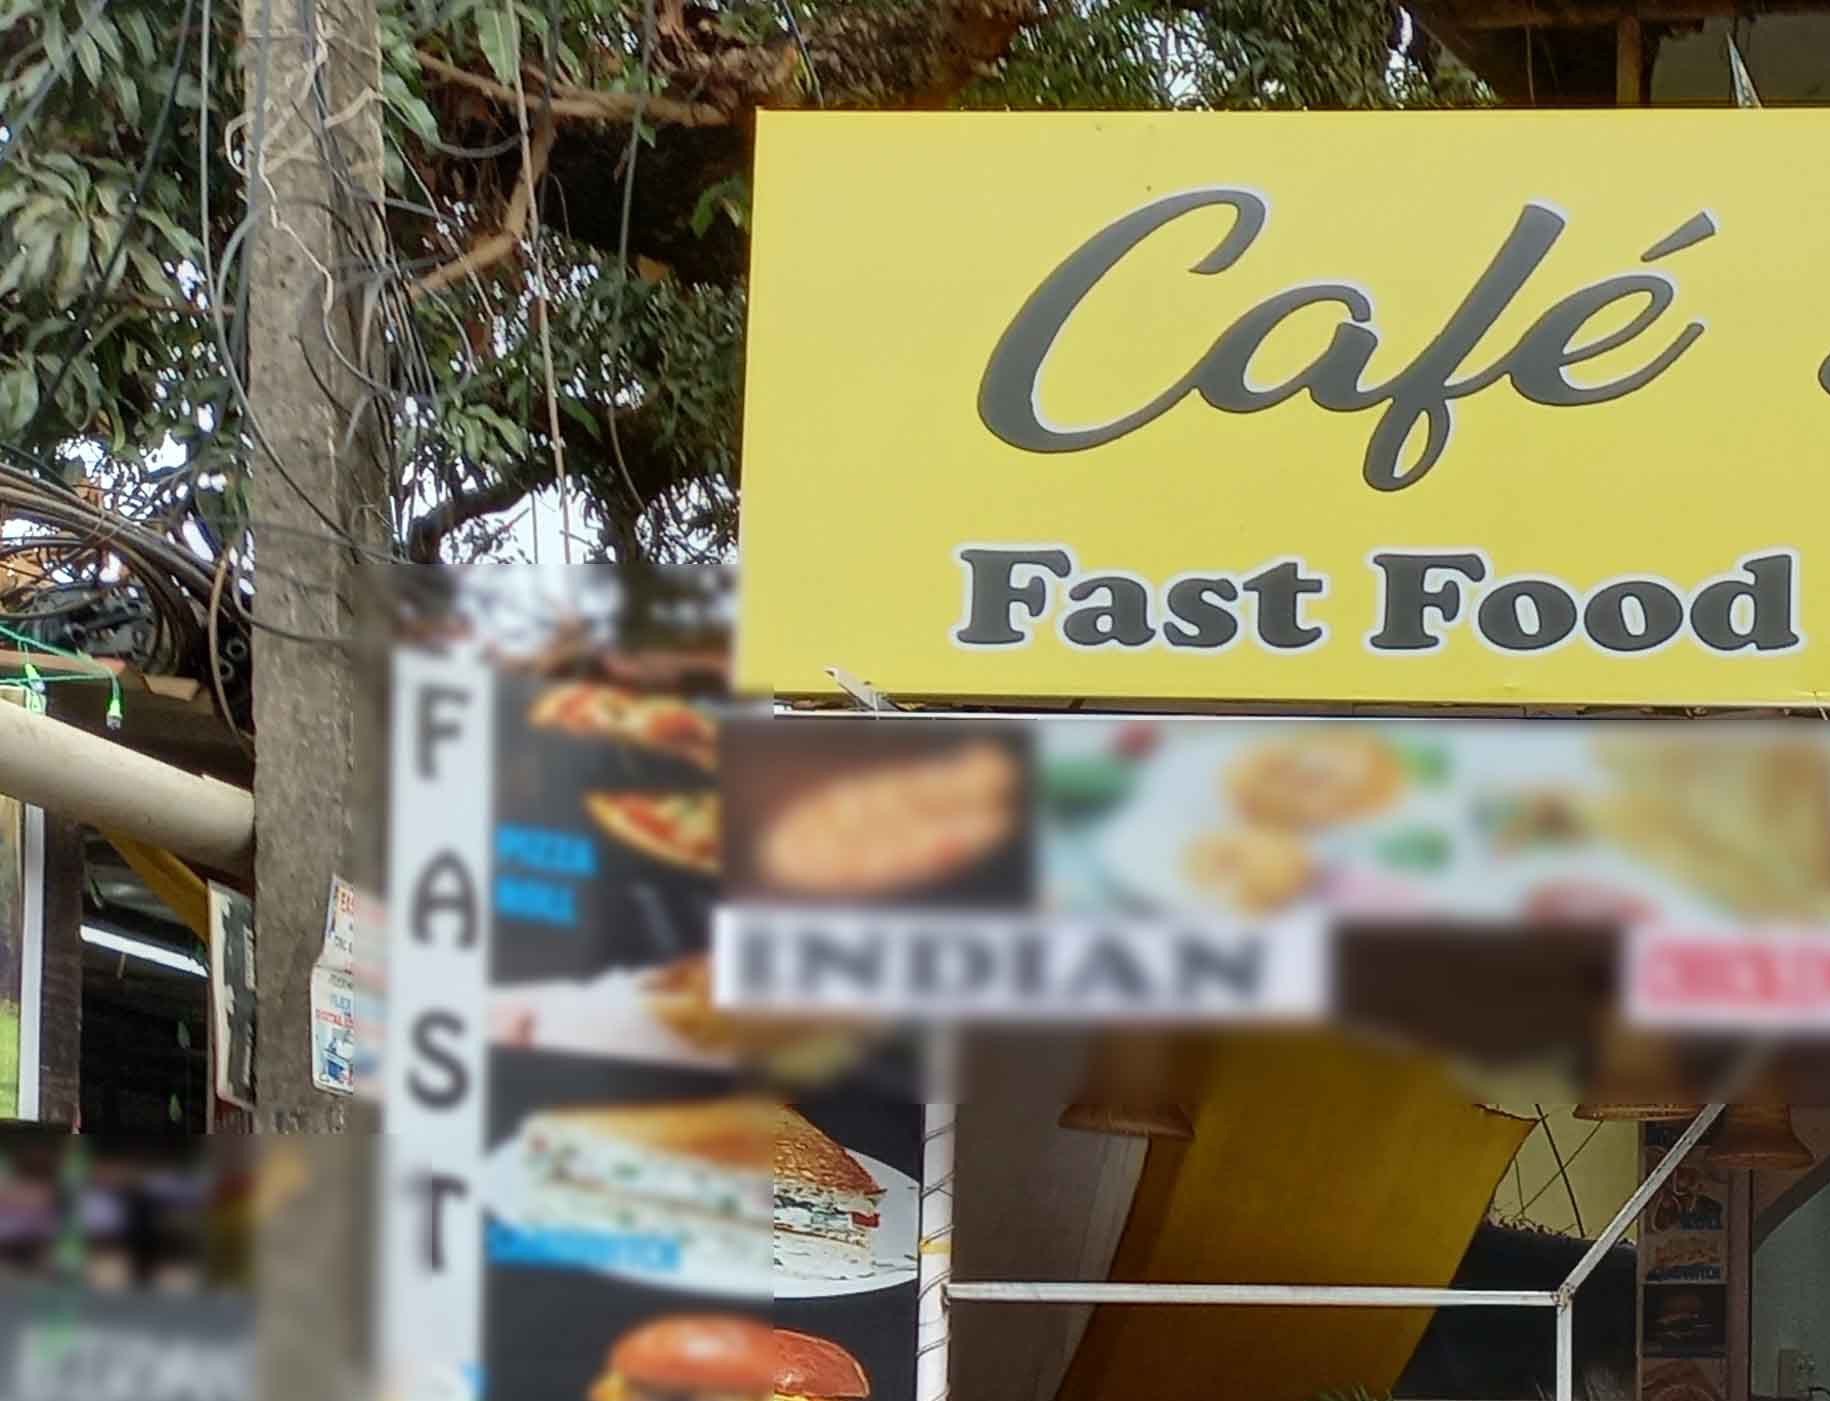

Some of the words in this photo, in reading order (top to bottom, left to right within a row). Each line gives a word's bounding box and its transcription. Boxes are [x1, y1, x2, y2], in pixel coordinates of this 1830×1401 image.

[976, 187, 1717, 492] Café
[955, 548, 1324, 649] Fast
[1369, 552, 1802, 652] Food
[738, 925, 1264, 1006] INDIAN
